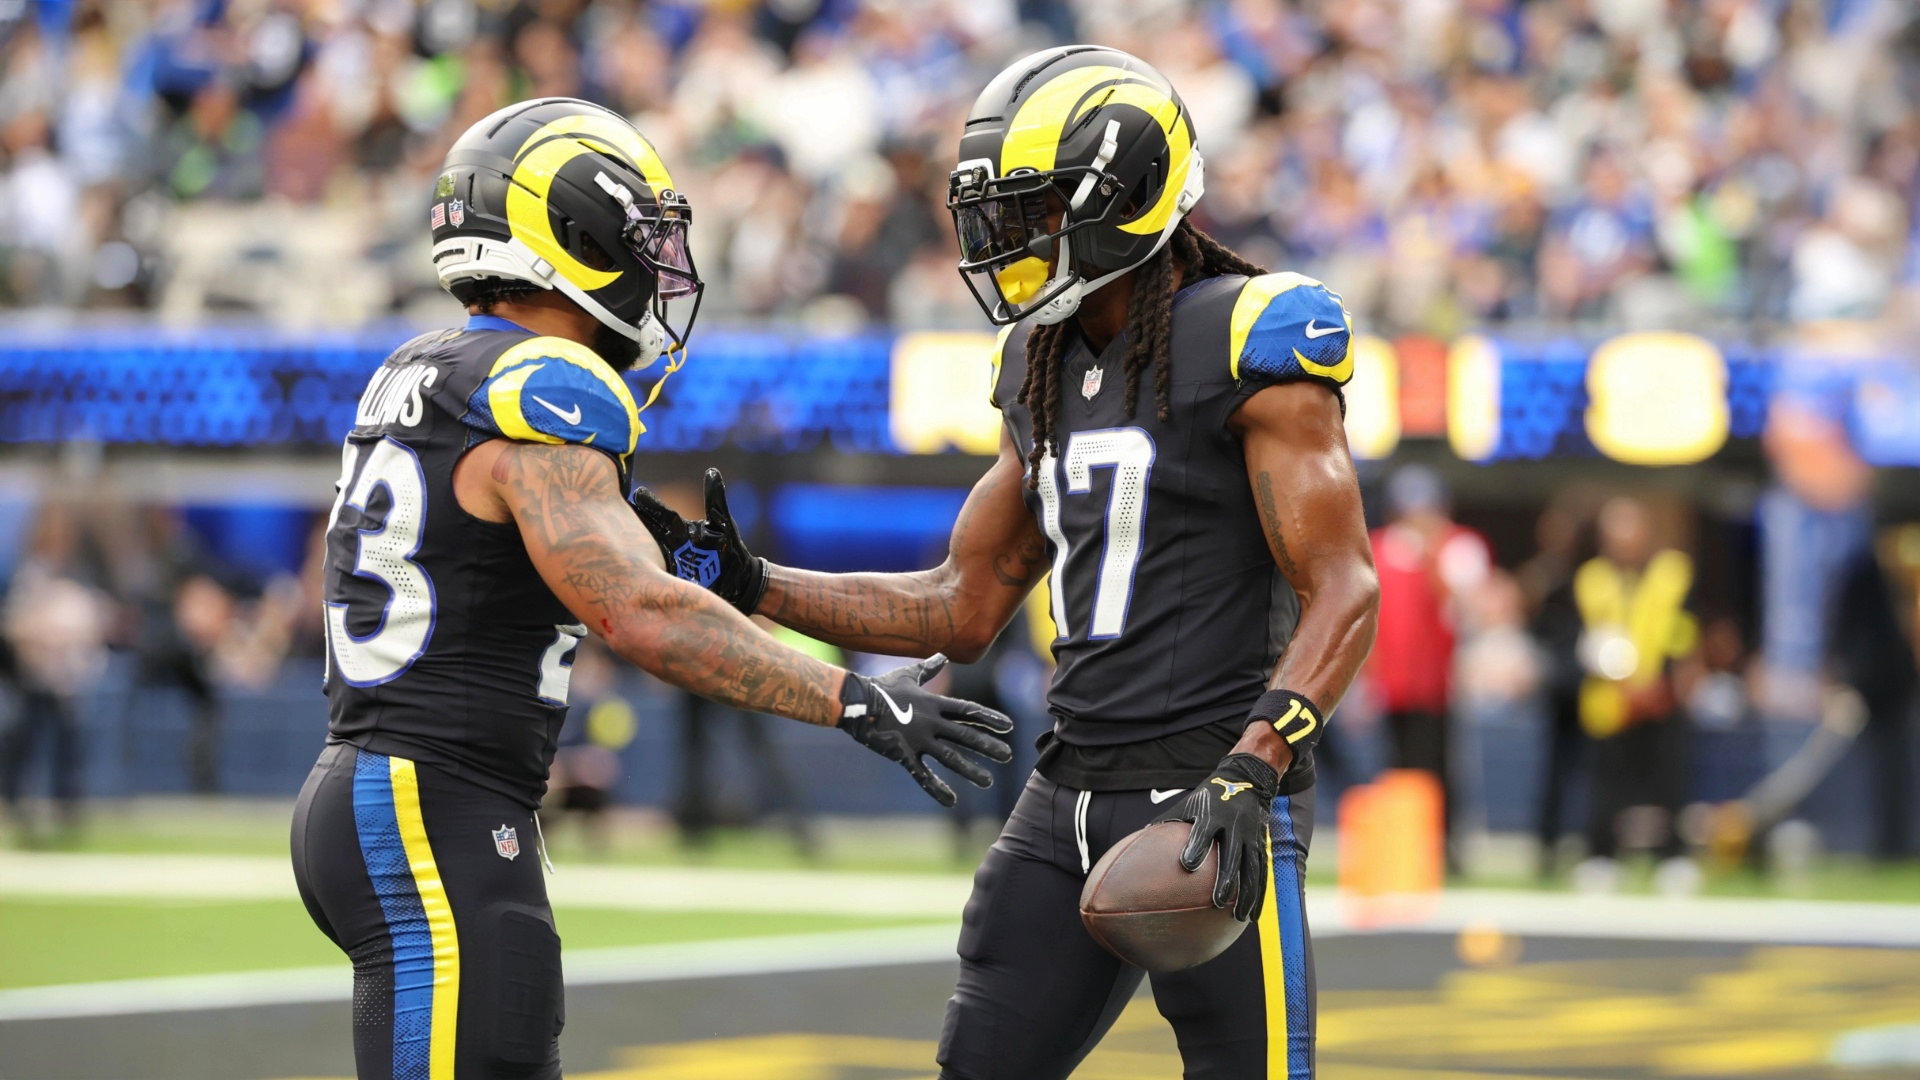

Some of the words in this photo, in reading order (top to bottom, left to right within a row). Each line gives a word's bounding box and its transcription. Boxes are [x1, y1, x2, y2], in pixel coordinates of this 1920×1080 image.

[1022, 425, 1157, 641] 17
[704, 559, 717, 580] 17
[1273, 698, 1317, 745] 17
